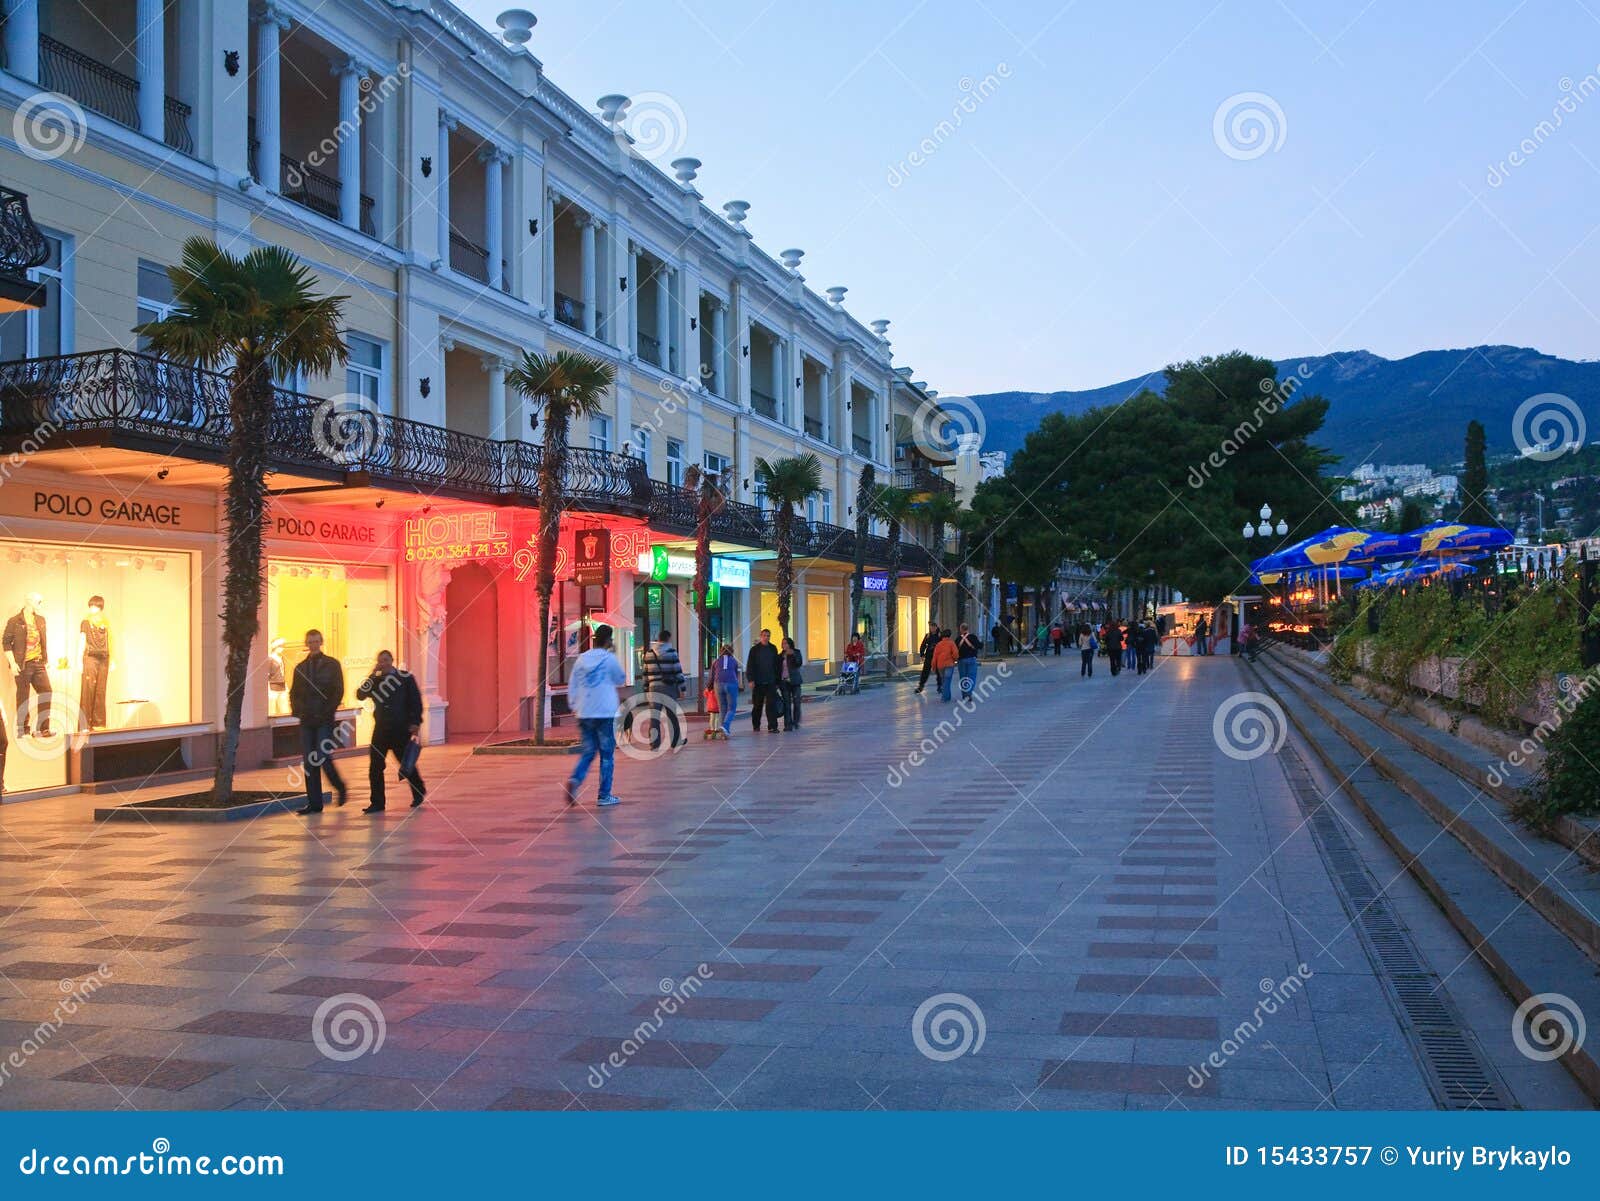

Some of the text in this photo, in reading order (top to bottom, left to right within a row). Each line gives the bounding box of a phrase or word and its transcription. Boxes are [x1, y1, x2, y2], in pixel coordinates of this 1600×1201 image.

[34, 492, 181, 526] POLO GARAGE
[277, 517, 375, 543] POLO GARAGE
[405, 511, 507, 547] HOTEL
[416, 546, 444, 560] 050
